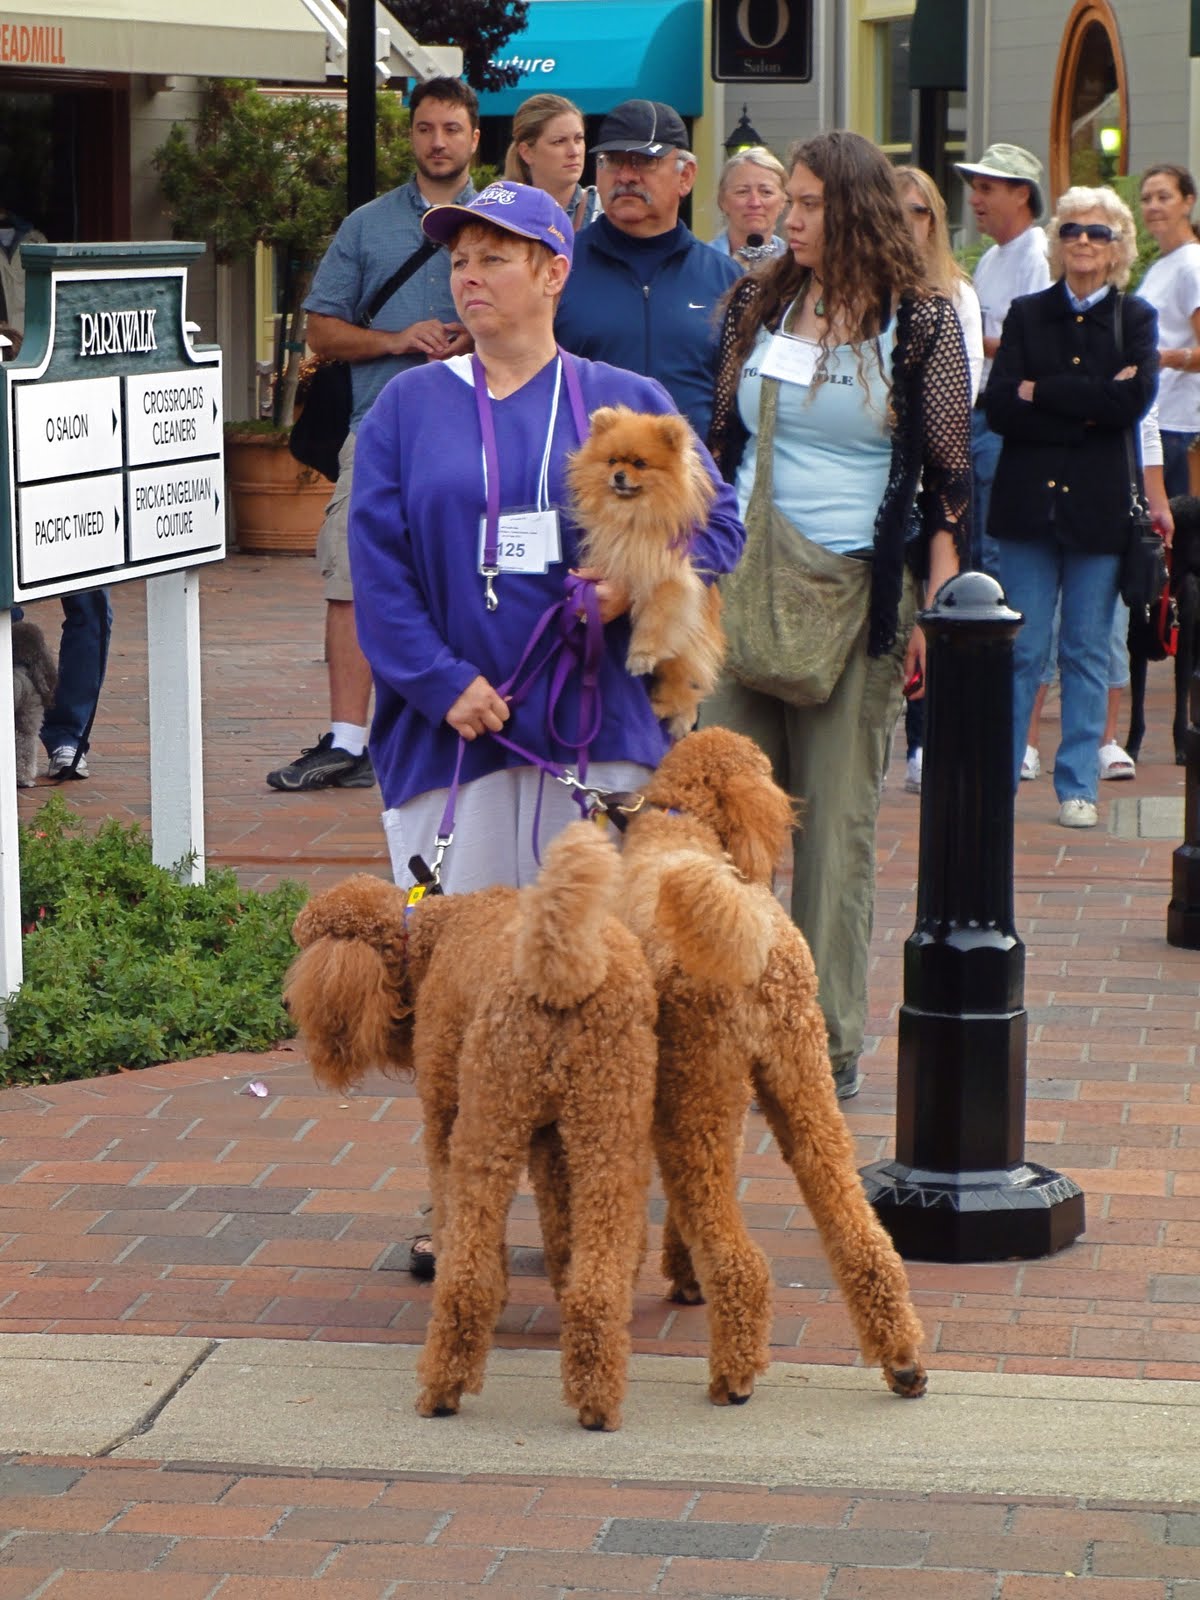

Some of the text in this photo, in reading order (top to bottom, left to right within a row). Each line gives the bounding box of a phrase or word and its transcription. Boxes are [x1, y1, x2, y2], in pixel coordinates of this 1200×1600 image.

[0, 24, 65, 64] EADMILL
[743, 59, 781, 73] Salon
[79, 309, 157, 356] PARKWALK
[143, 386, 204, 415] CROSSROADS
[46, 413, 89, 442] O SALON
[153, 417, 197, 445] CLEANERS
[136, 477, 212, 511] ERICKA ENGELMAN
[35, 510, 104, 546] PACIFIC TWEED
[156, 511, 193, 539] COUTURE
[496, 542, 525, 557] 125
